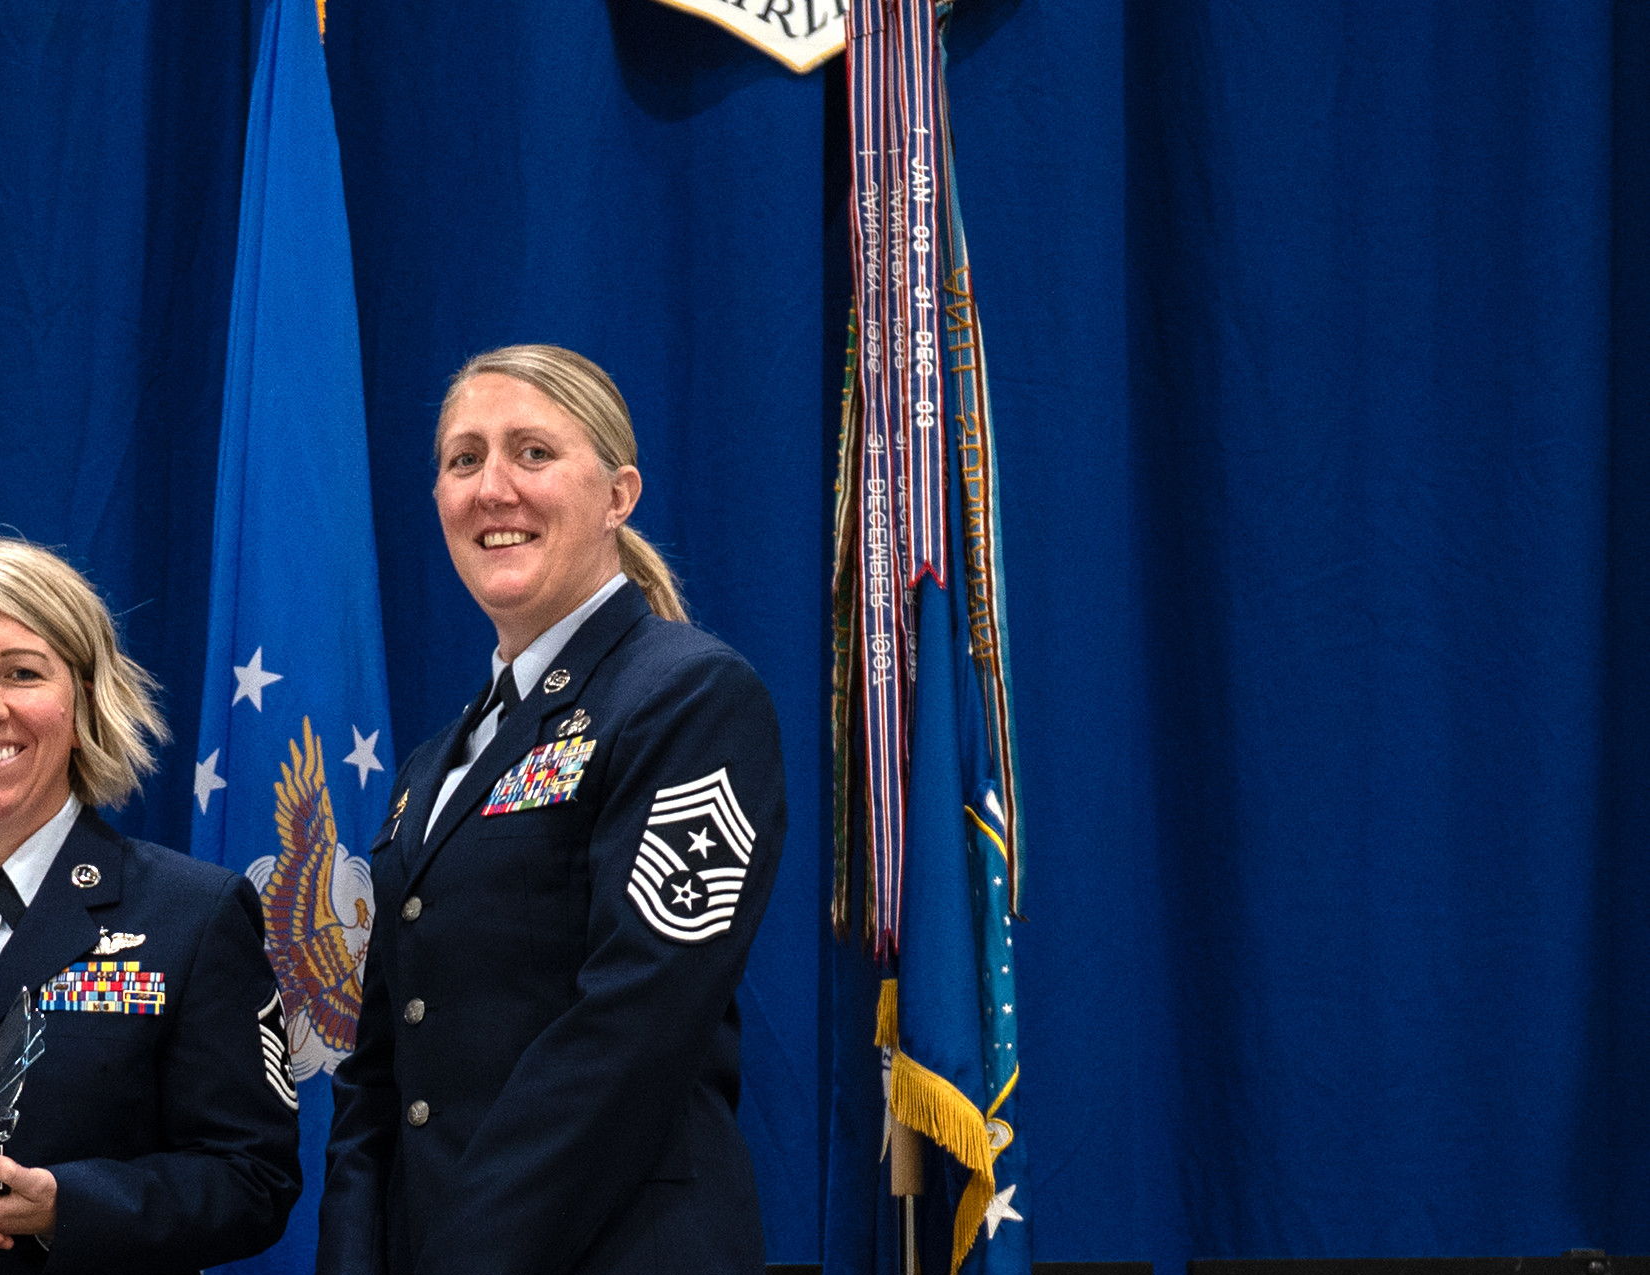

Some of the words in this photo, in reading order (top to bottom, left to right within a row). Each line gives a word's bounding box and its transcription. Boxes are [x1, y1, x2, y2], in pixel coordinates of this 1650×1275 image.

[911, 157, 931, 203] JAN
[913, 224, 930, 253] 03
[914, 285, 933, 309] 31
[915, 331, 934, 377] DEC
[915, 400, 934, 428] 03
